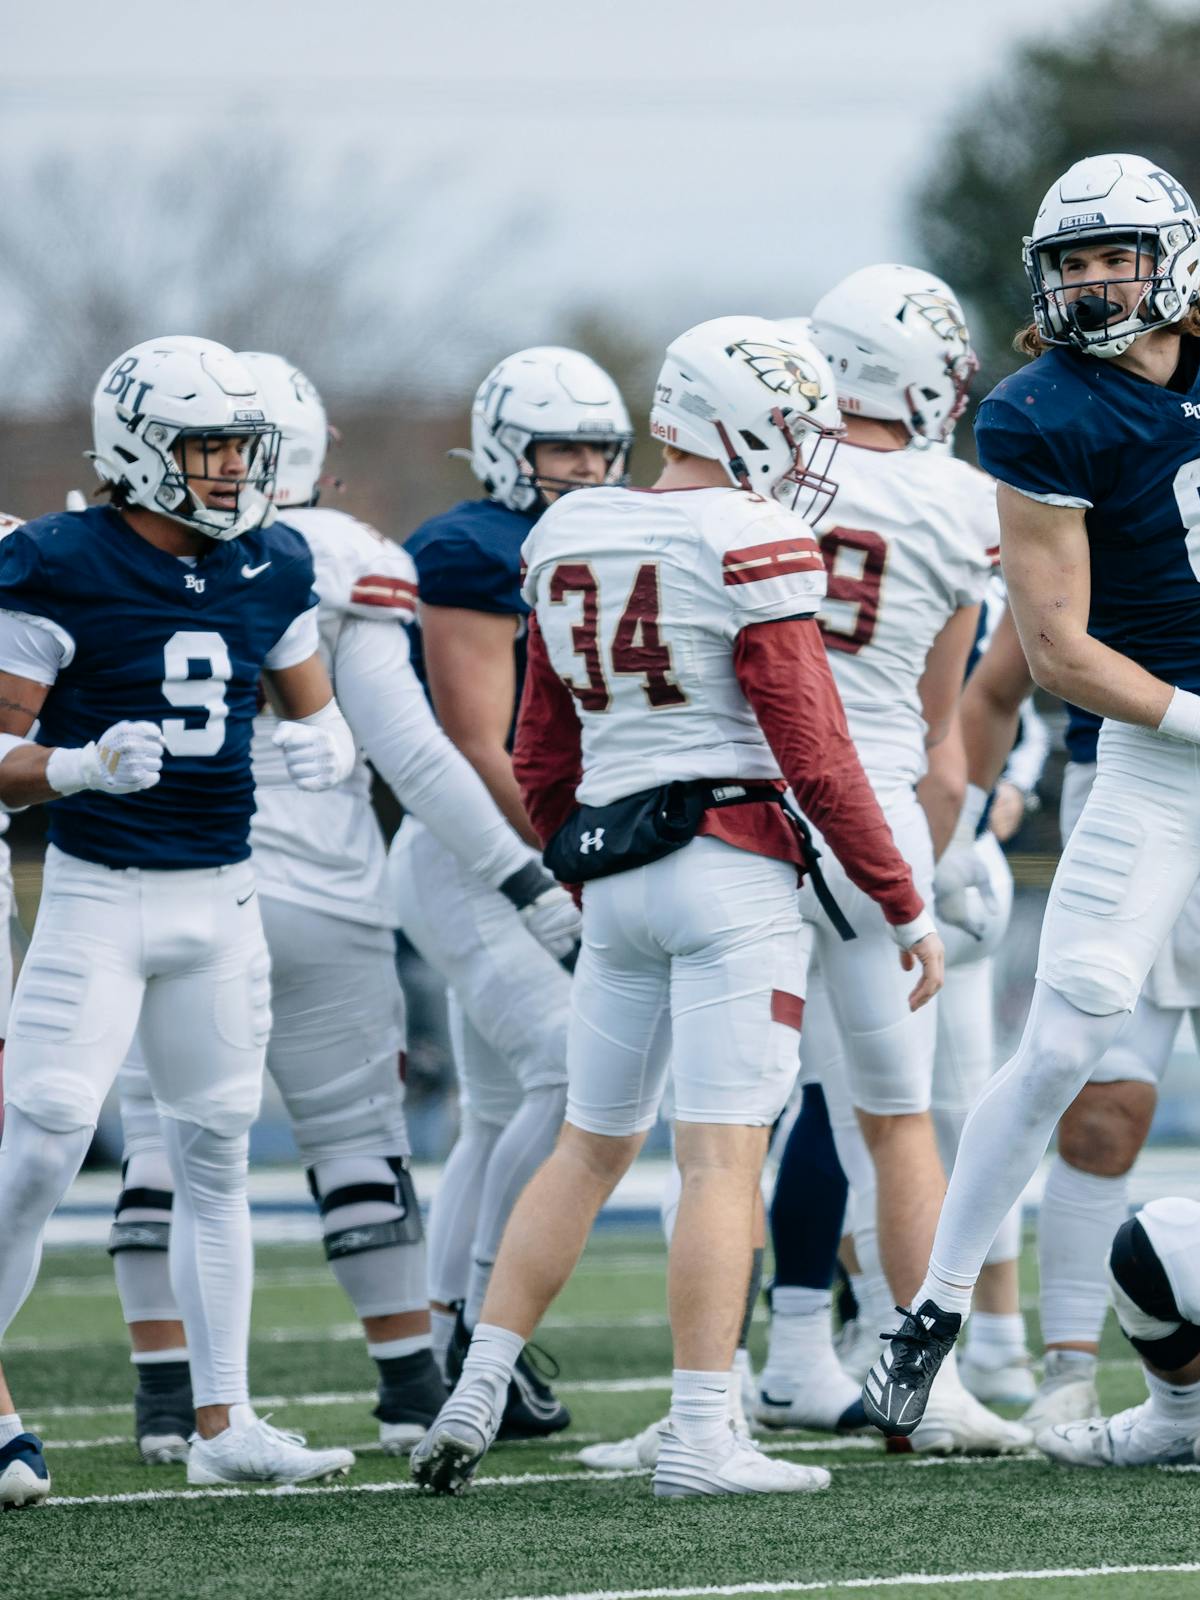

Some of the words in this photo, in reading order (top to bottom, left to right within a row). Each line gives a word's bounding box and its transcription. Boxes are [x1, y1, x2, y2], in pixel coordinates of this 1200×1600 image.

[1061, 213, 1101, 229] BETHEL
[183, 573, 206, 594] BU
[549, 560, 691, 713] 34
[815, 524, 888, 657] 9
[161, 630, 233, 757] 9
